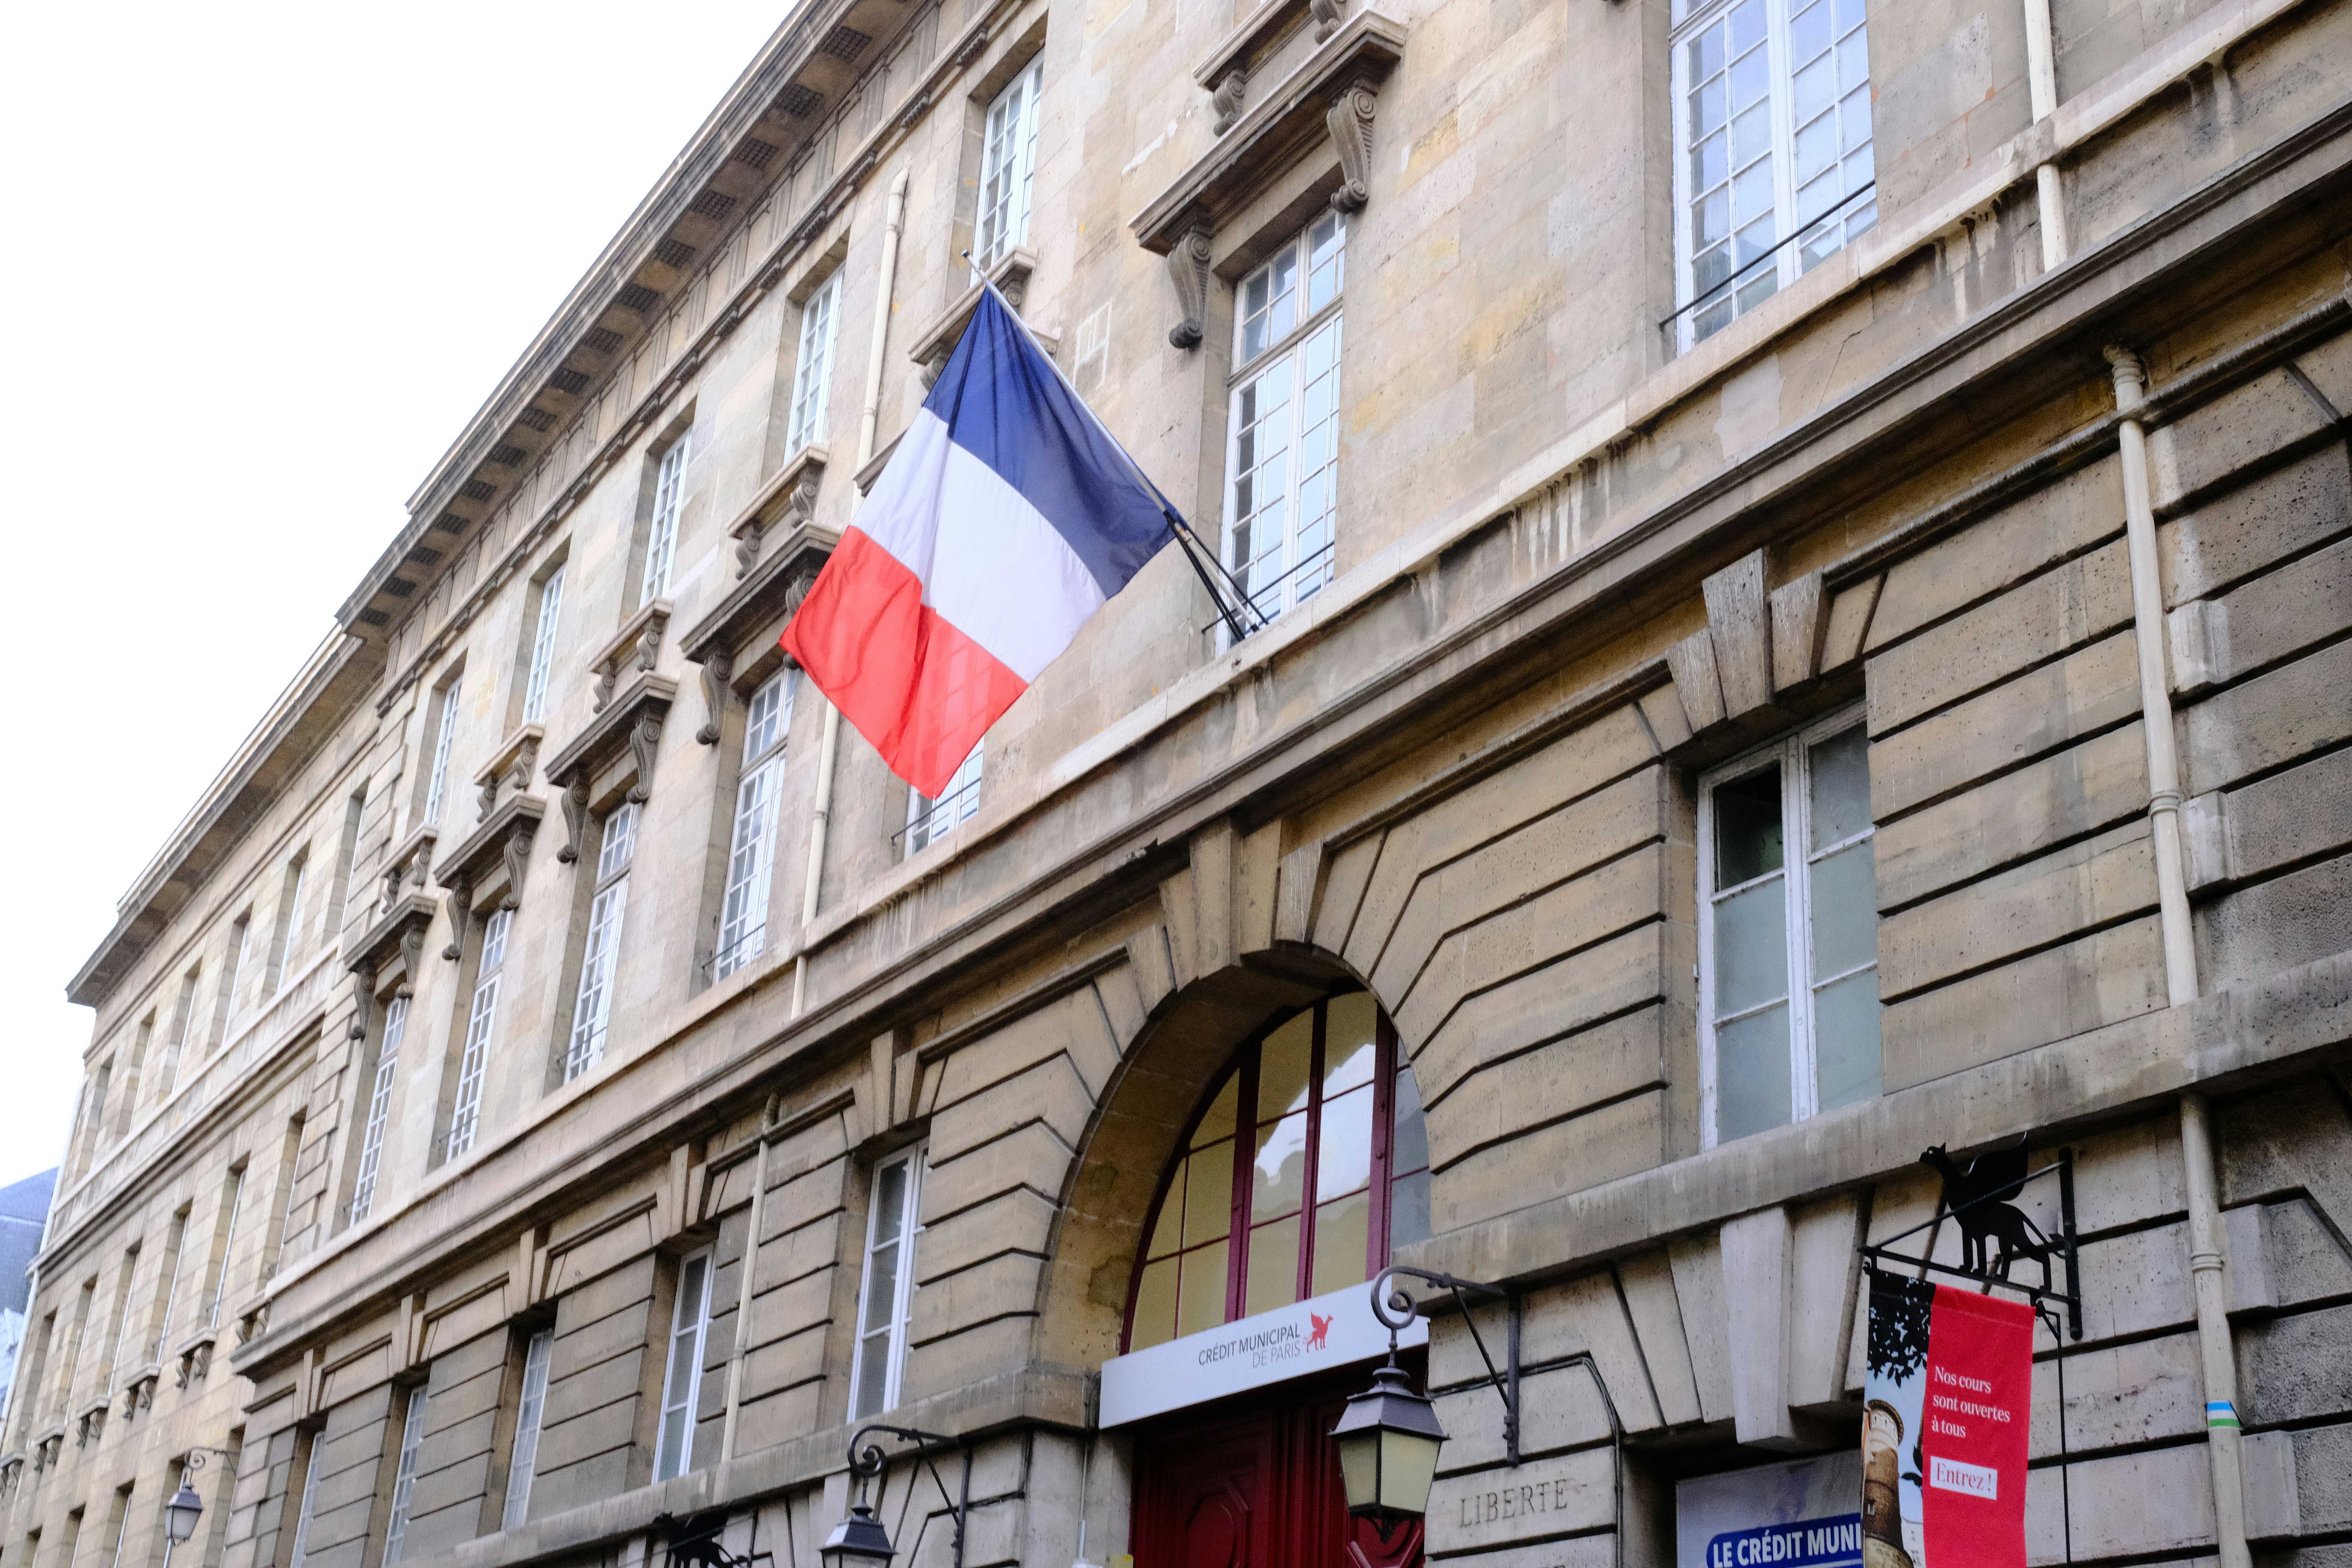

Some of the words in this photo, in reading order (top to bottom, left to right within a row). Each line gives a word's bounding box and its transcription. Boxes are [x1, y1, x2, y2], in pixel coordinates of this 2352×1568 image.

[1199, 1342, 1236, 1365] CRÉDIT
[1239, 1323, 1300, 1354] MUNICIPAL
[1253, 1349, 1267, 1368] DE
[1271, 1340, 1300, 1363] PARIS
[1935, 1365, 1956, 1386] Nos
[1959, 1376, 1991, 1394] cours
[1933, 1395, 1958, 1411] sont
[1961, 1401, 2010, 1423] ouvertes
[1932, 1415, 1939, 1432] à
[1942, 1419, 1966, 1438] tous
[1713, 1541, 1732, 1568] LE
[1737, 1529, 1802, 1566] CRÉDIT
